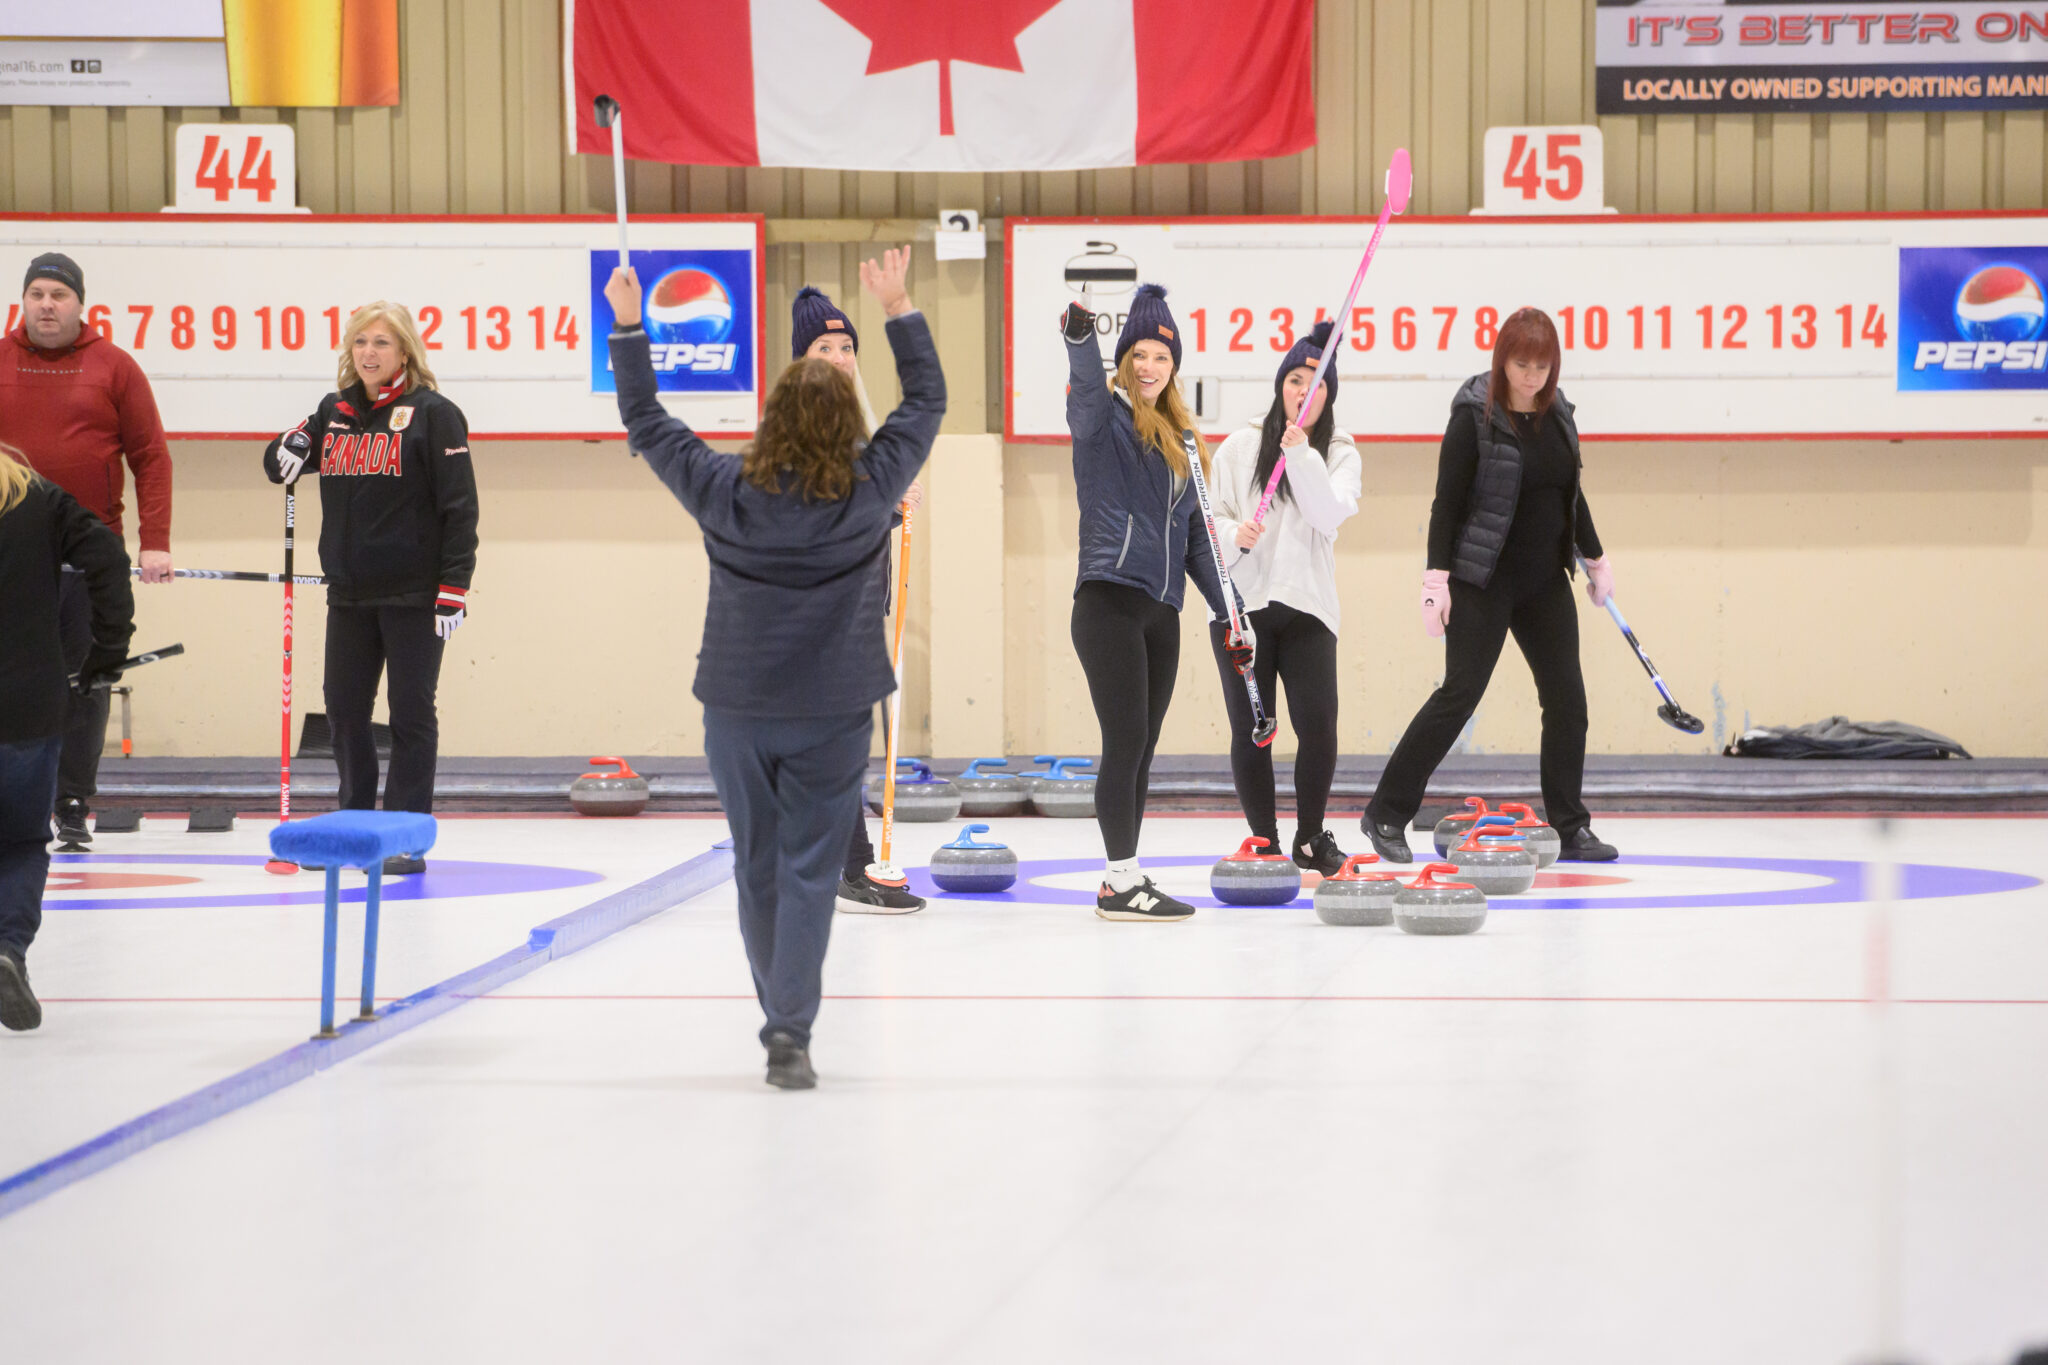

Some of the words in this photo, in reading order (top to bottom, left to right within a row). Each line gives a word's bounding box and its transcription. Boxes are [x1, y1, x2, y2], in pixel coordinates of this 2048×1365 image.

[1627, 15, 1722, 45] IT'S
[1739, 13, 1959, 44] BETTER
[1975, 11, 2048, 42] ON
[1623, 79, 1727, 100] LOCALLY
[1731, 77, 1823, 99] OWNED
[1827, 76, 1981, 98] SUPPORTING
[195, 135, 277, 203] 44
[1503, 133, 1584, 202] 45
[87, 304, 113, 346] 6
[127, 304, 154, 350] 7
[170, 304, 196, 351] 8
[211, 305, 237, 351] 9
[254, 305, 306, 351] 10
[459, 305, 511, 352] 13
[527, 305, 580, 351] 14
[1189, 307, 1207, 353] 1
[1228, 307, 1254, 353] 2
[1269, 307, 1295, 353] 3
[1350, 306, 1376, 352] 5
[1392, 306, 1417, 352] 6
[1431, 306, 1458, 351] 7
[1474, 305, 1500, 352] 8
[1557, 305, 1609, 351] 10
[1626, 305, 1672, 350] 11
[1695, 304, 1748, 350] 12
[1765, 303, 1818, 350] 13
[1835, 303, 1888, 349] 14
[607, 343, 737, 372] EPSI
[1913, 340, 2048, 371] PEPSI
[321, 432, 403, 477] CANADA
[1192, 462, 1210, 512] CARBON
[286, 494, 295, 528] ASHAM
[281, 782, 290, 816] ASHAM
[1126, 890, 1161, 912] N
